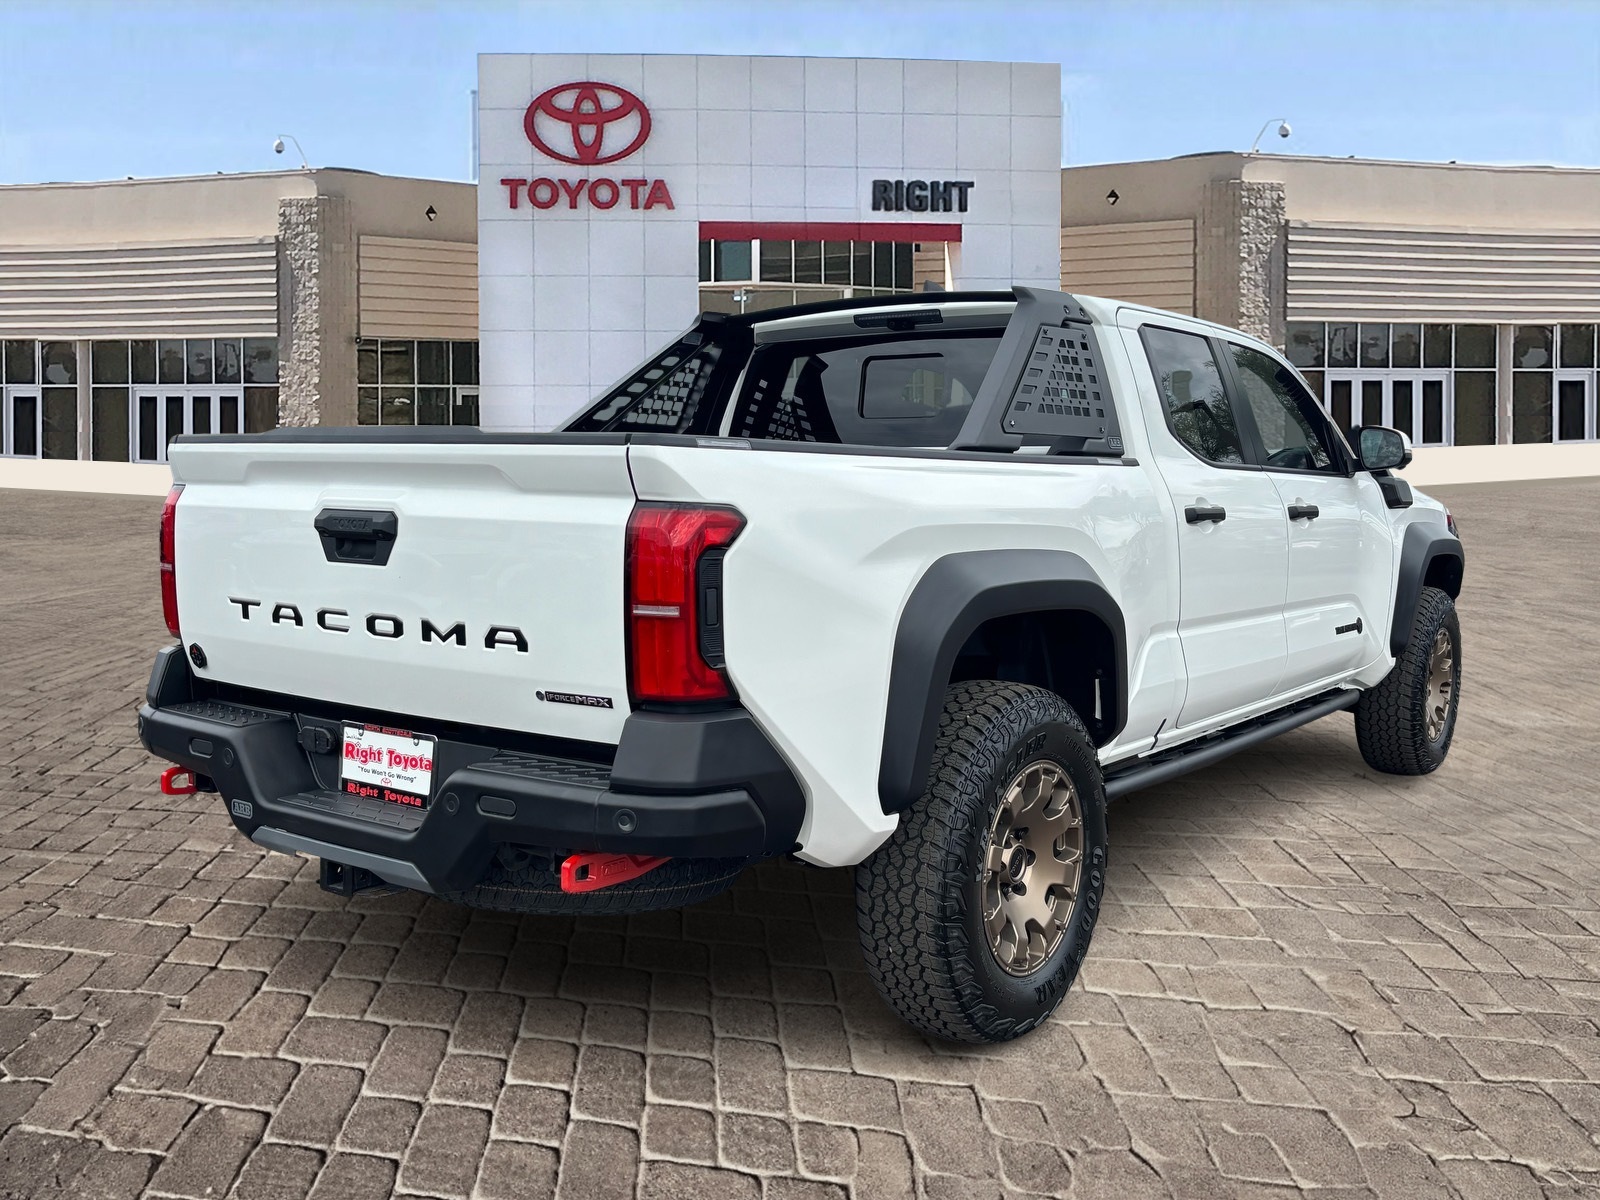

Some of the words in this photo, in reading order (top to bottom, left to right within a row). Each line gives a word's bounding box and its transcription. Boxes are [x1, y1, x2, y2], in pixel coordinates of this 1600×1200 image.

[500, 178, 675, 210] TOYOTA
[871, 179, 975, 212] RIGHT
[333, 517, 370, 531] TOYOTA
[228, 596, 529, 653] TACOMA
[344, 741, 383, 764] Right
[387, 748, 432, 771] Toyota
[358, 766, 370, 774] "You
[396, 774, 416, 783] Wrong"
[347, 783, 378, 797] Right
[384, 790, 422, 806] Toyota
[233, 801, 251, 816] ARB
